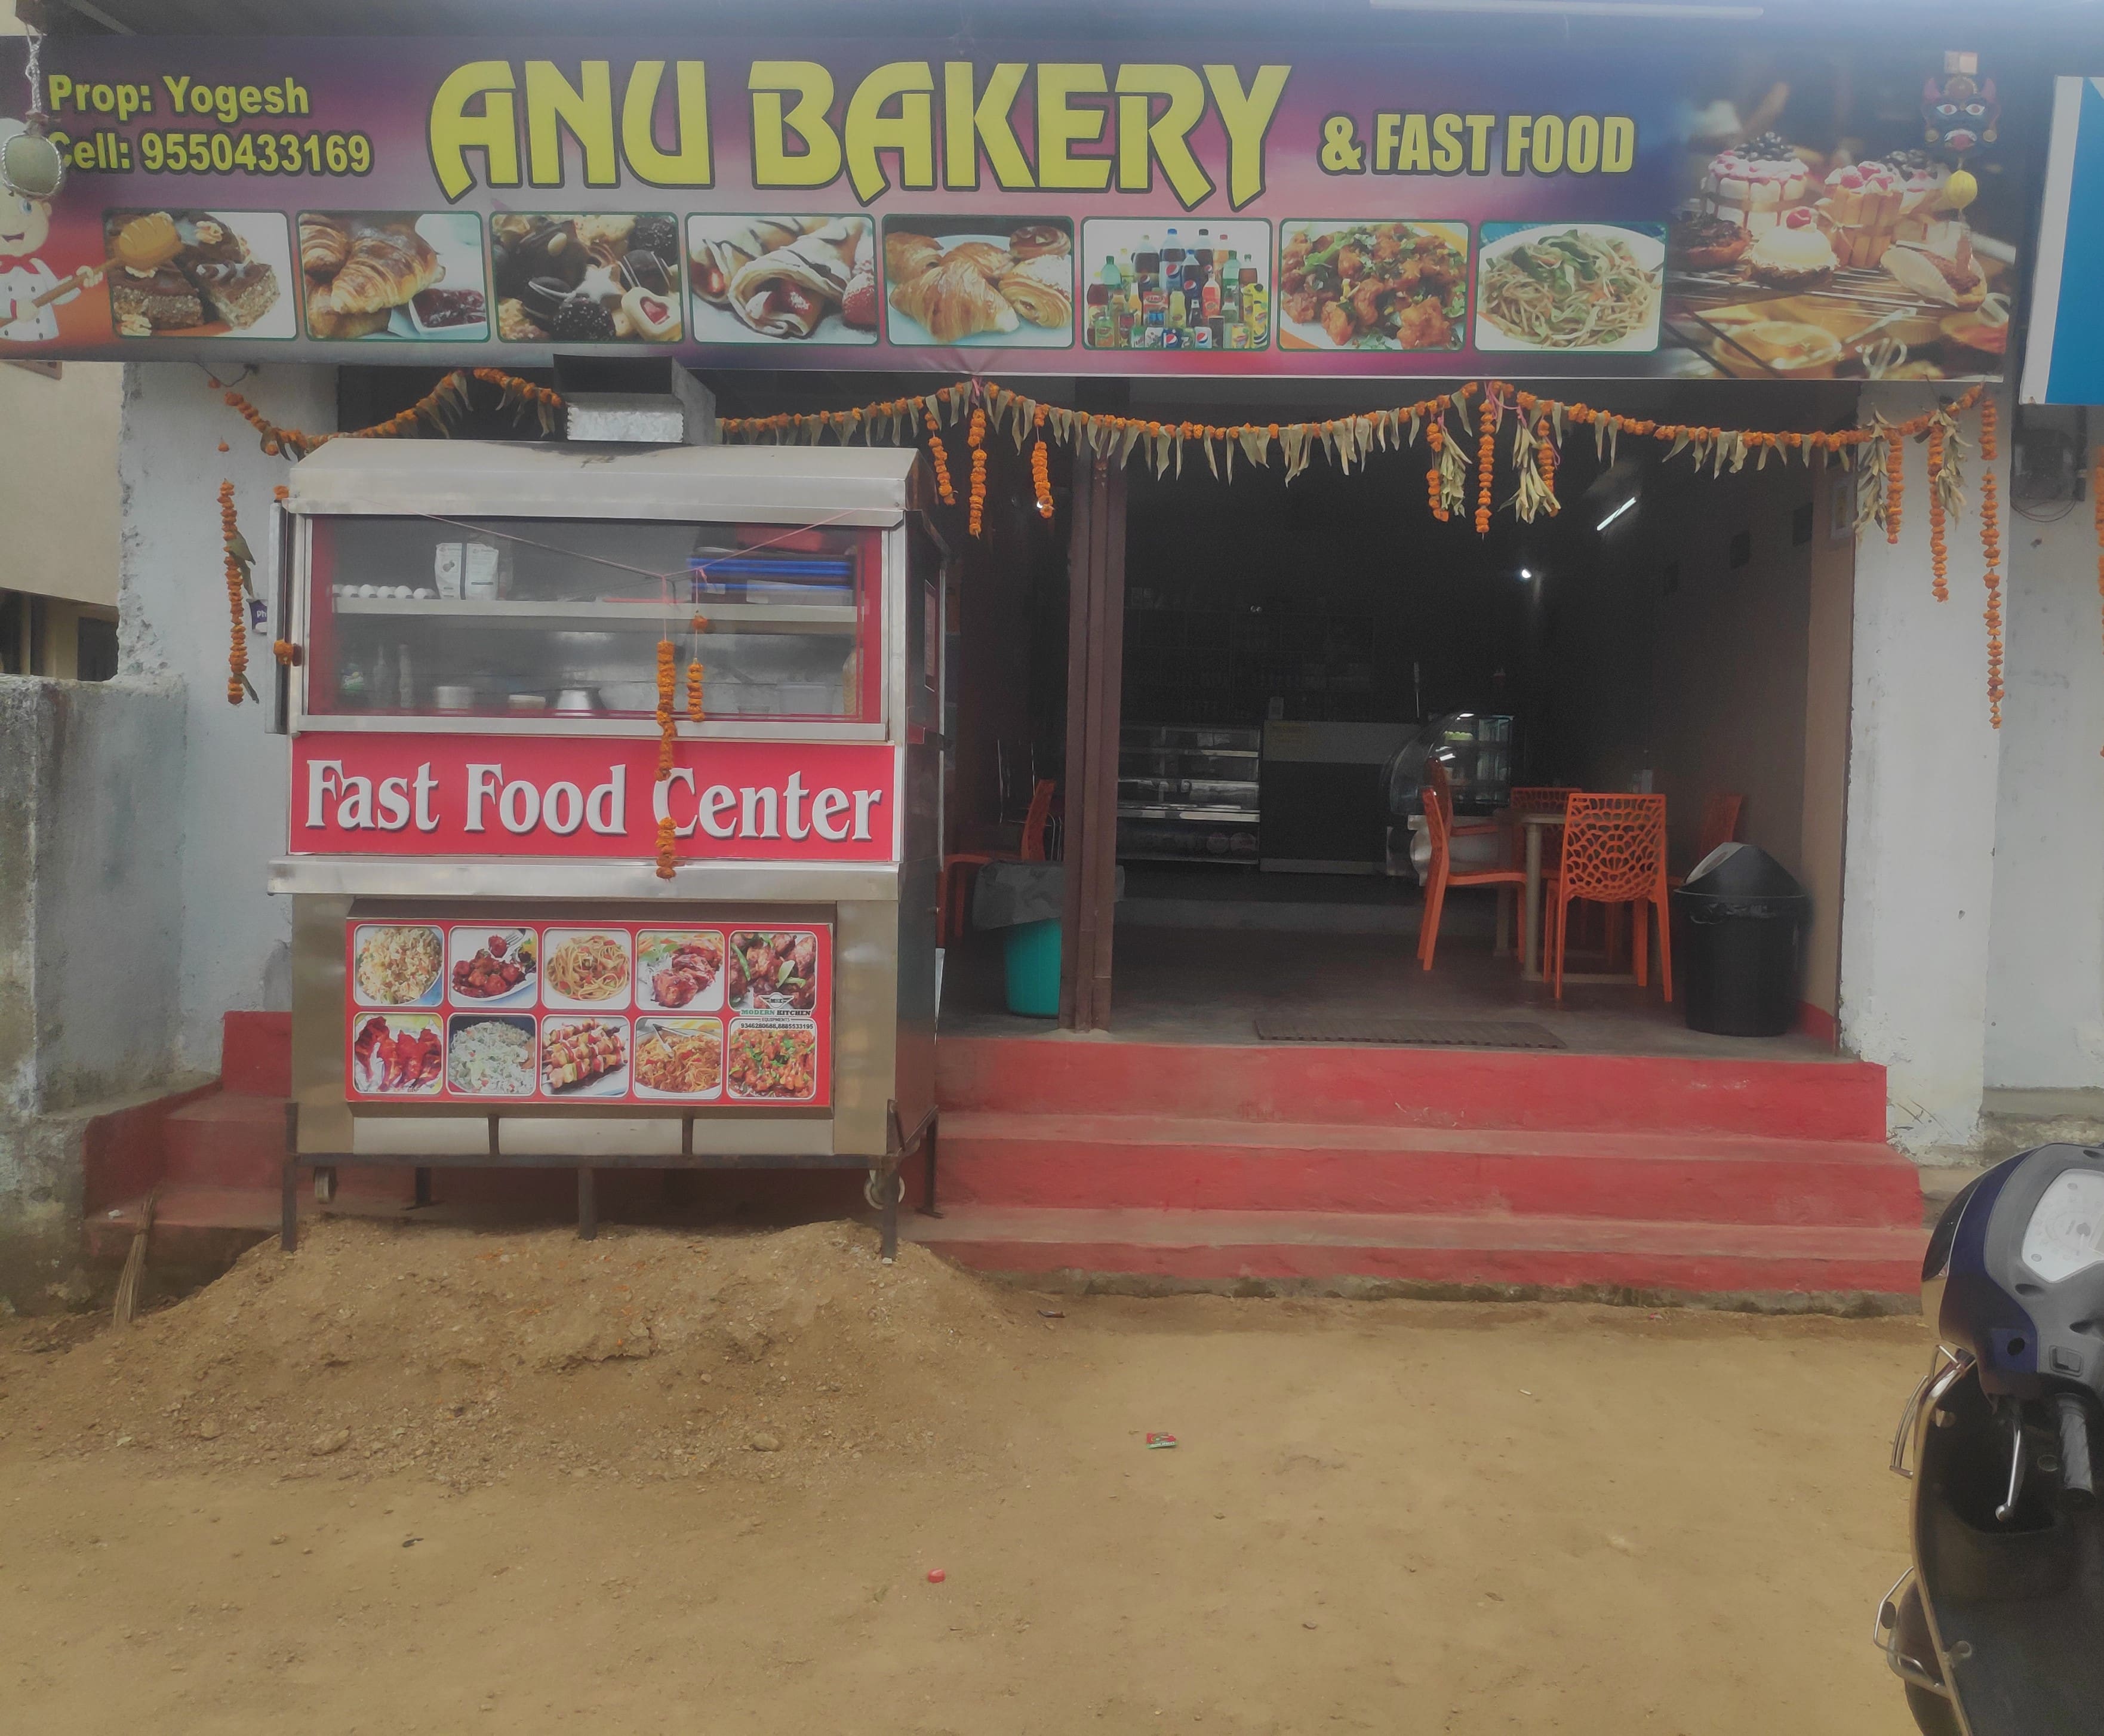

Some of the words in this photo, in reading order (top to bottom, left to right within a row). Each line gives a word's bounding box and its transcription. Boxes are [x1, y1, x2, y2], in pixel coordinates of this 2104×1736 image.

[49, 75, 152, 121] Prop:
[162, 76, 309, 124] Yogesh
[48, 131, 131, 170] Cell:
[141, 133, 371, 173] 9550433169
[429, 60, 710, 204] ANU
[748, 61, 1292, 208] BAKERY
[1321, 116, 1362, 171] &
[1376, 113, 1495, 172] FAST
[1506, 114, 1635, 173] FOOD
[305, 759, 441, 832] Fast
[464, 764, 627, 835] Food
[653, 767, 883, 841] Center
